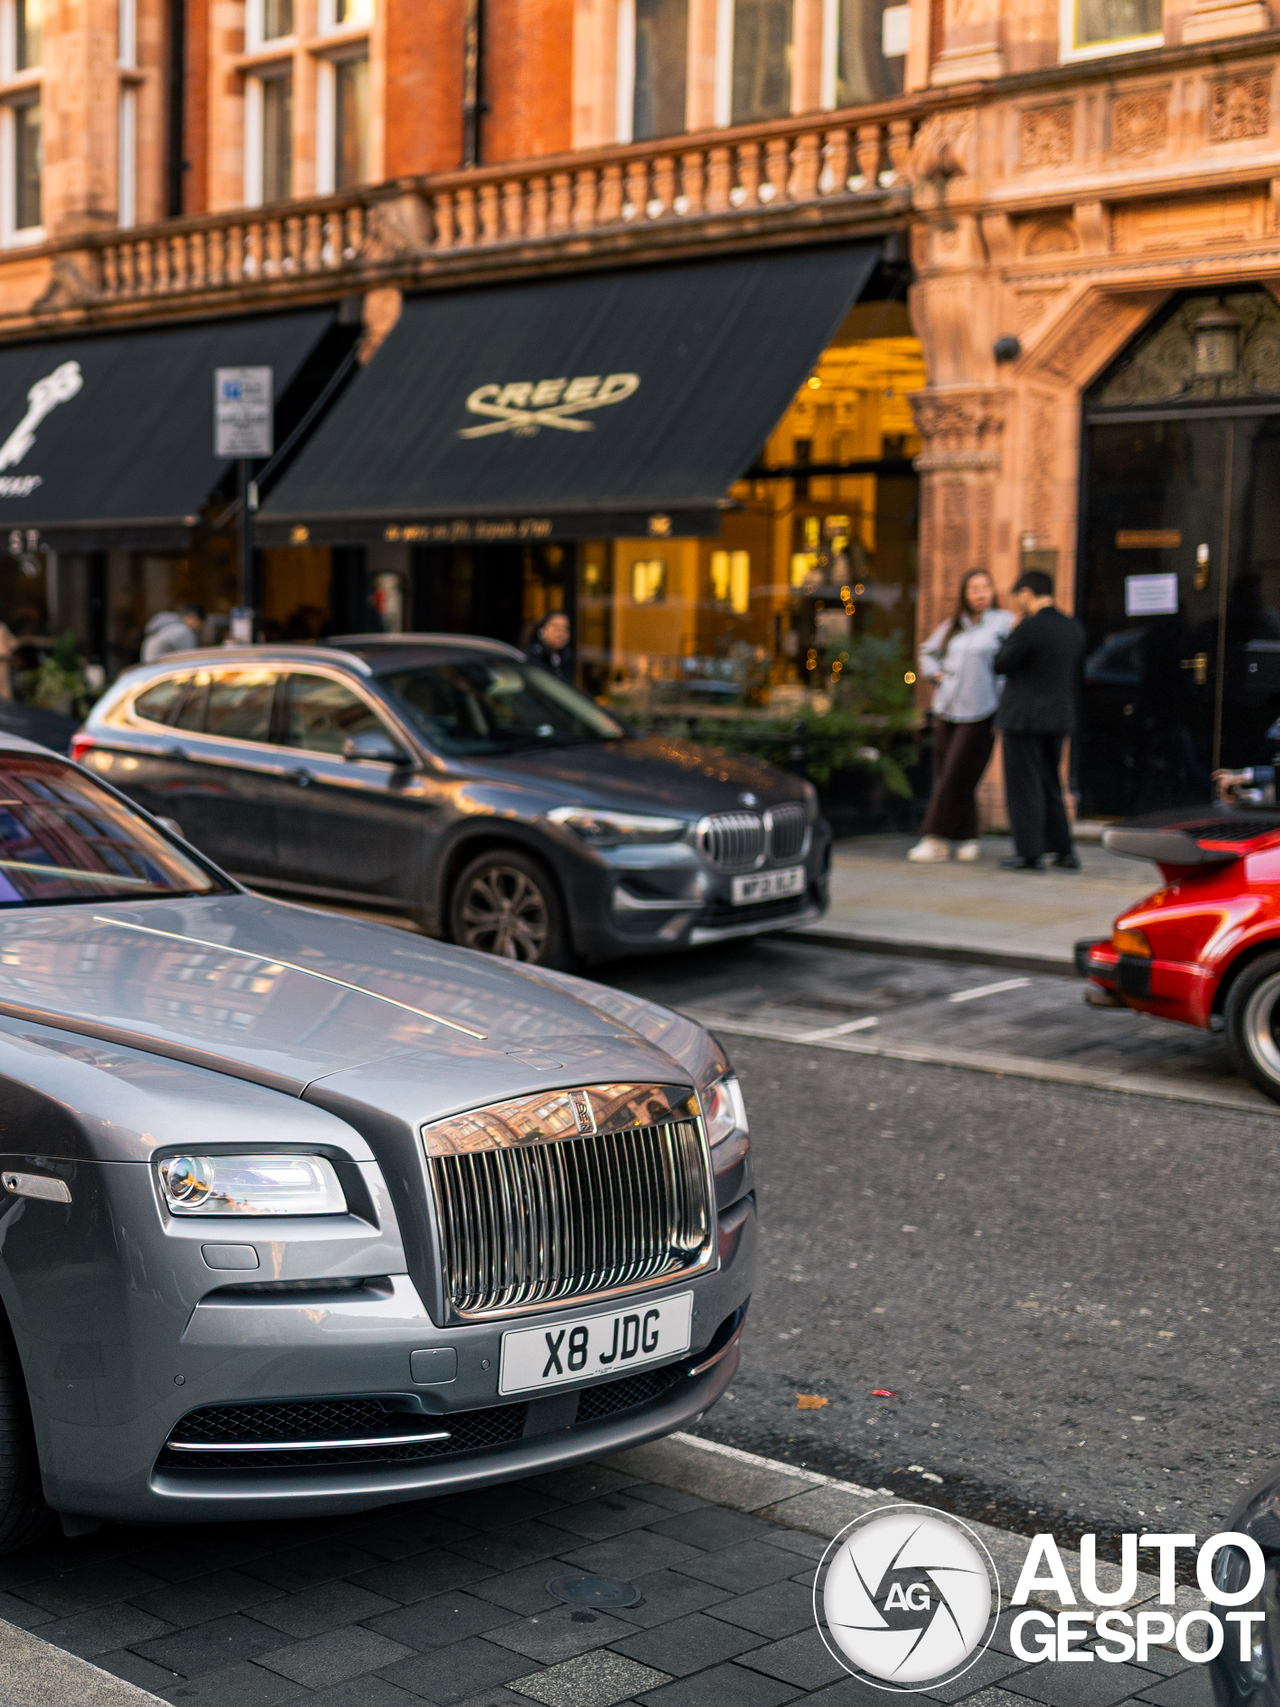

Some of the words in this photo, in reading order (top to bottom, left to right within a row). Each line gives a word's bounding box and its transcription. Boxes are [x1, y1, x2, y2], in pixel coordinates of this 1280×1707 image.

[460, 372, 641, 430] CREED
[542, 1326, 589, 1378] X8
[599, 1308, 660, 1364] JDG
